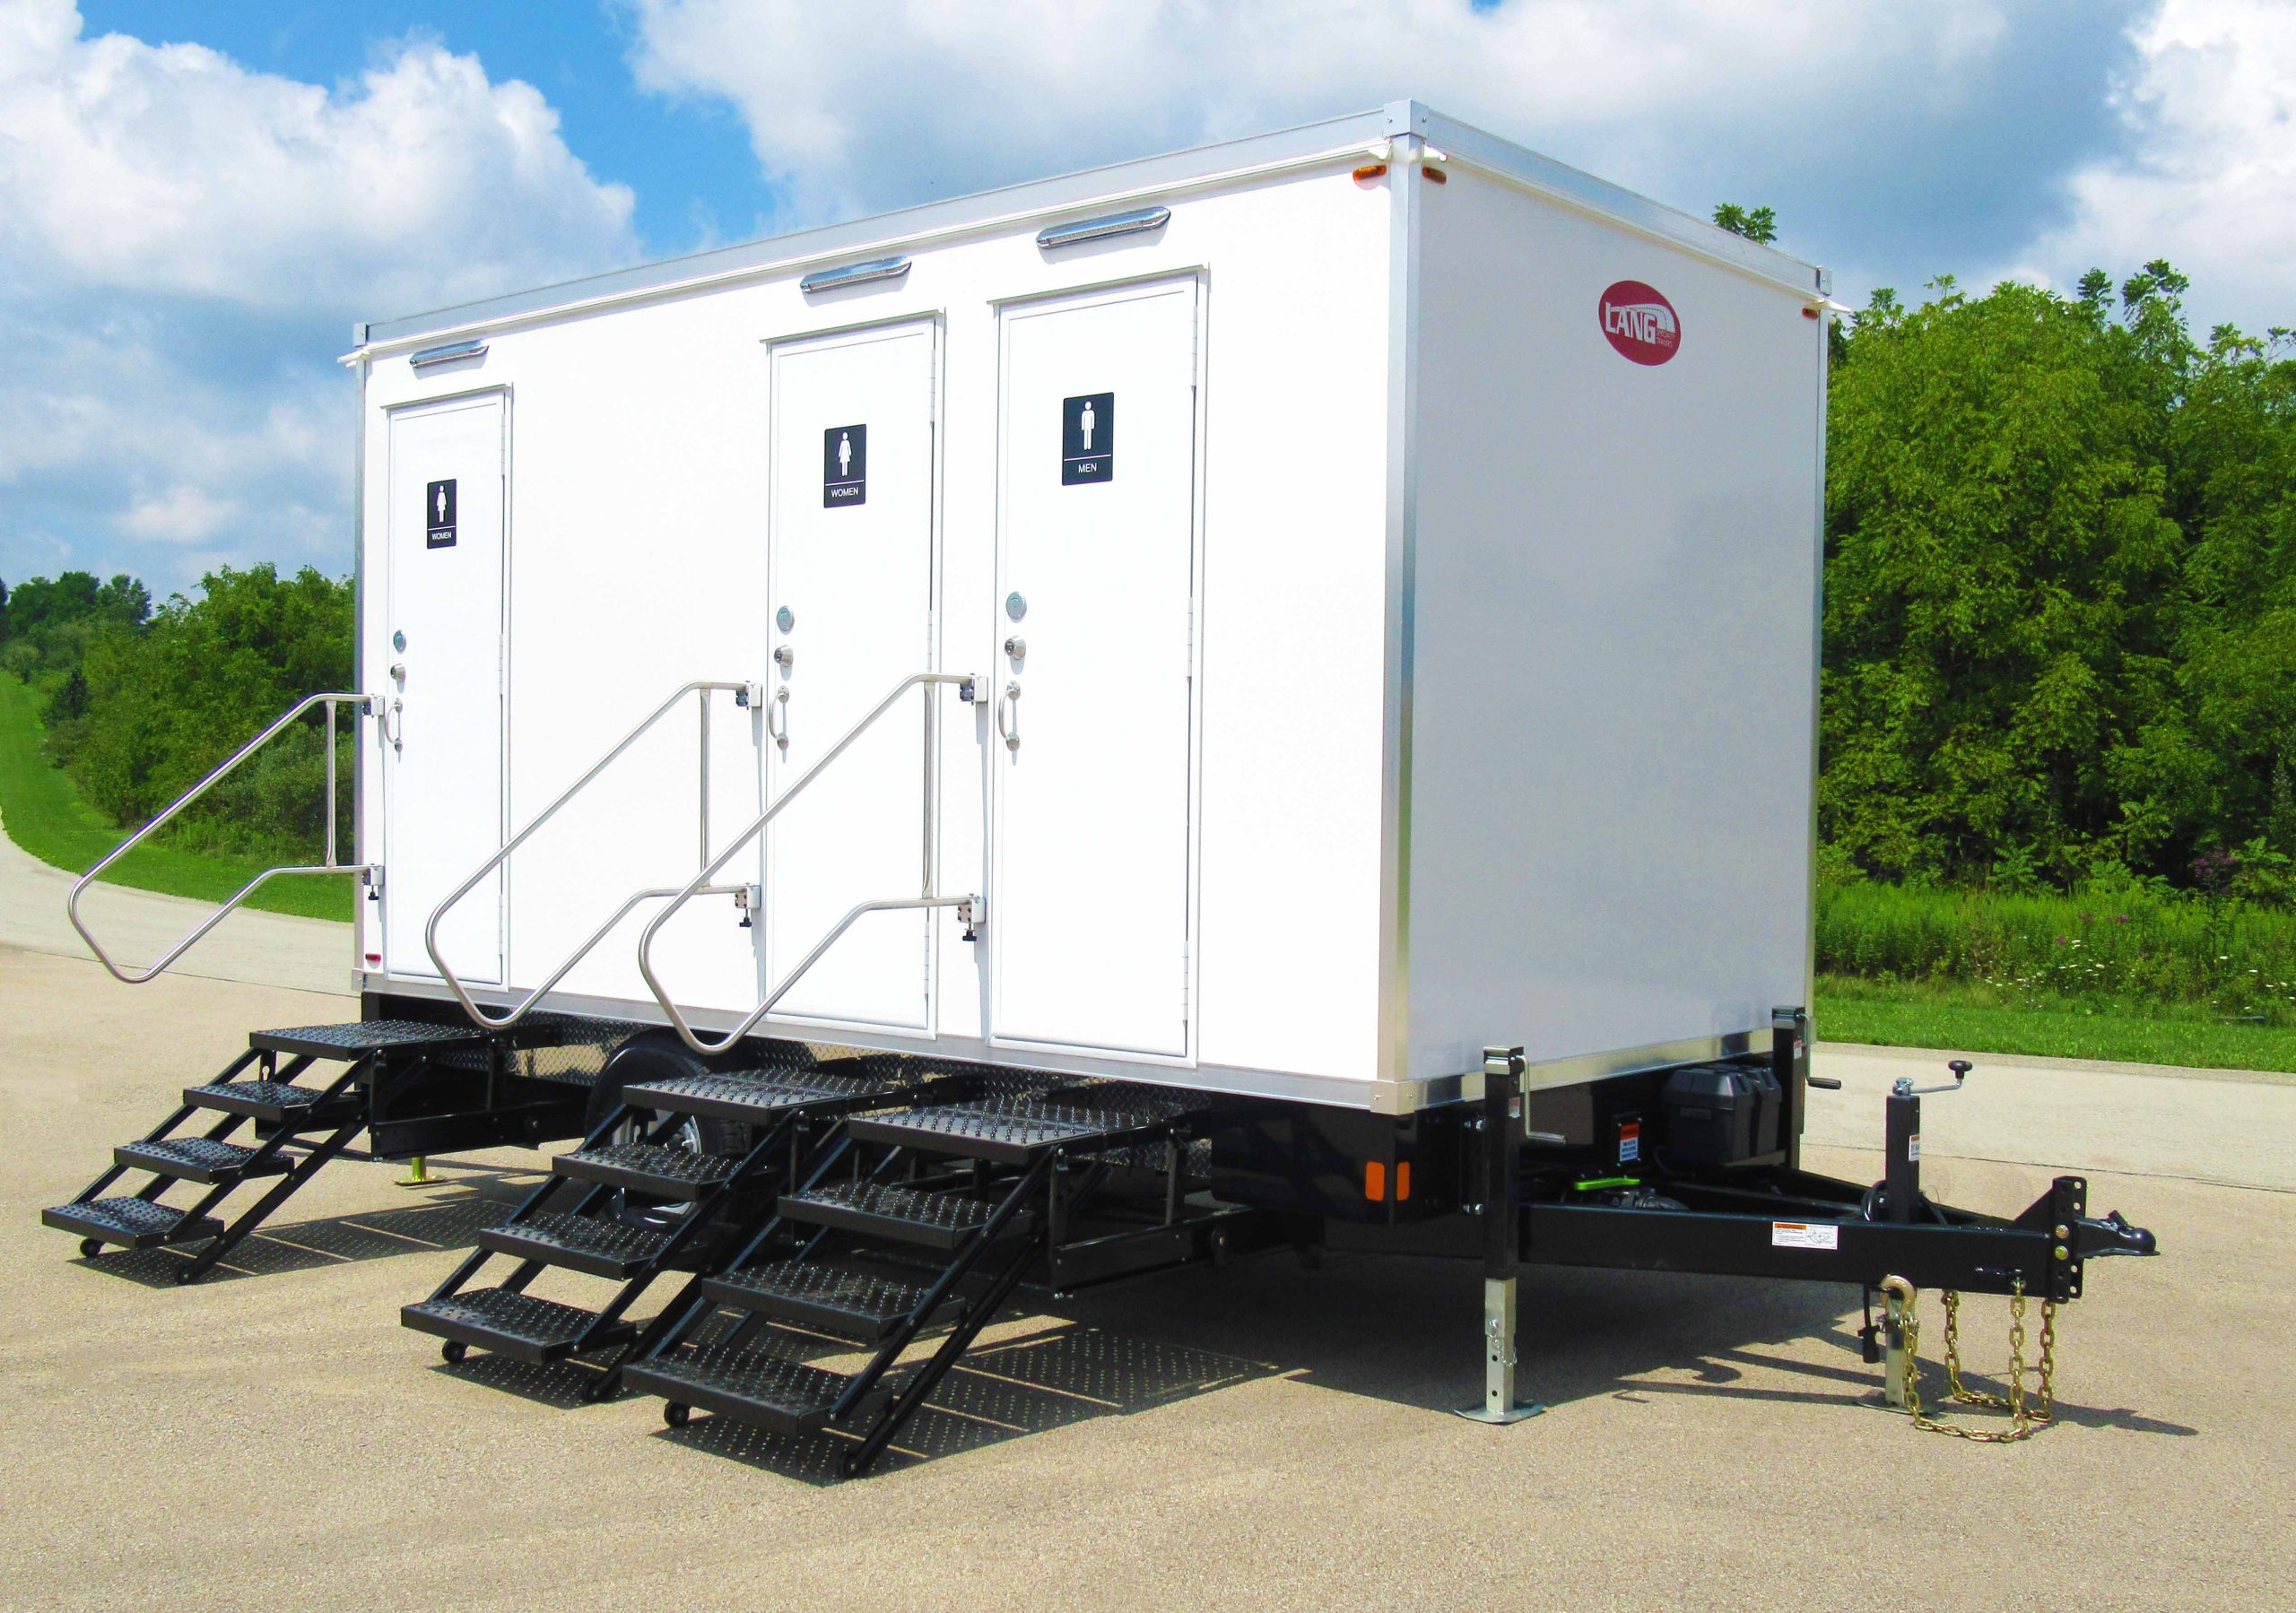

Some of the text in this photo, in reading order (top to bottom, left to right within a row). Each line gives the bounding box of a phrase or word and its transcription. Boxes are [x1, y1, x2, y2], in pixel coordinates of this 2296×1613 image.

[1605, 301, 1656, 345] LANG
[1078, 463, 1098, 473] MEN
[831, 487, 859, 498] WOMEN
[431, 531, 452, 541] WOMEN
